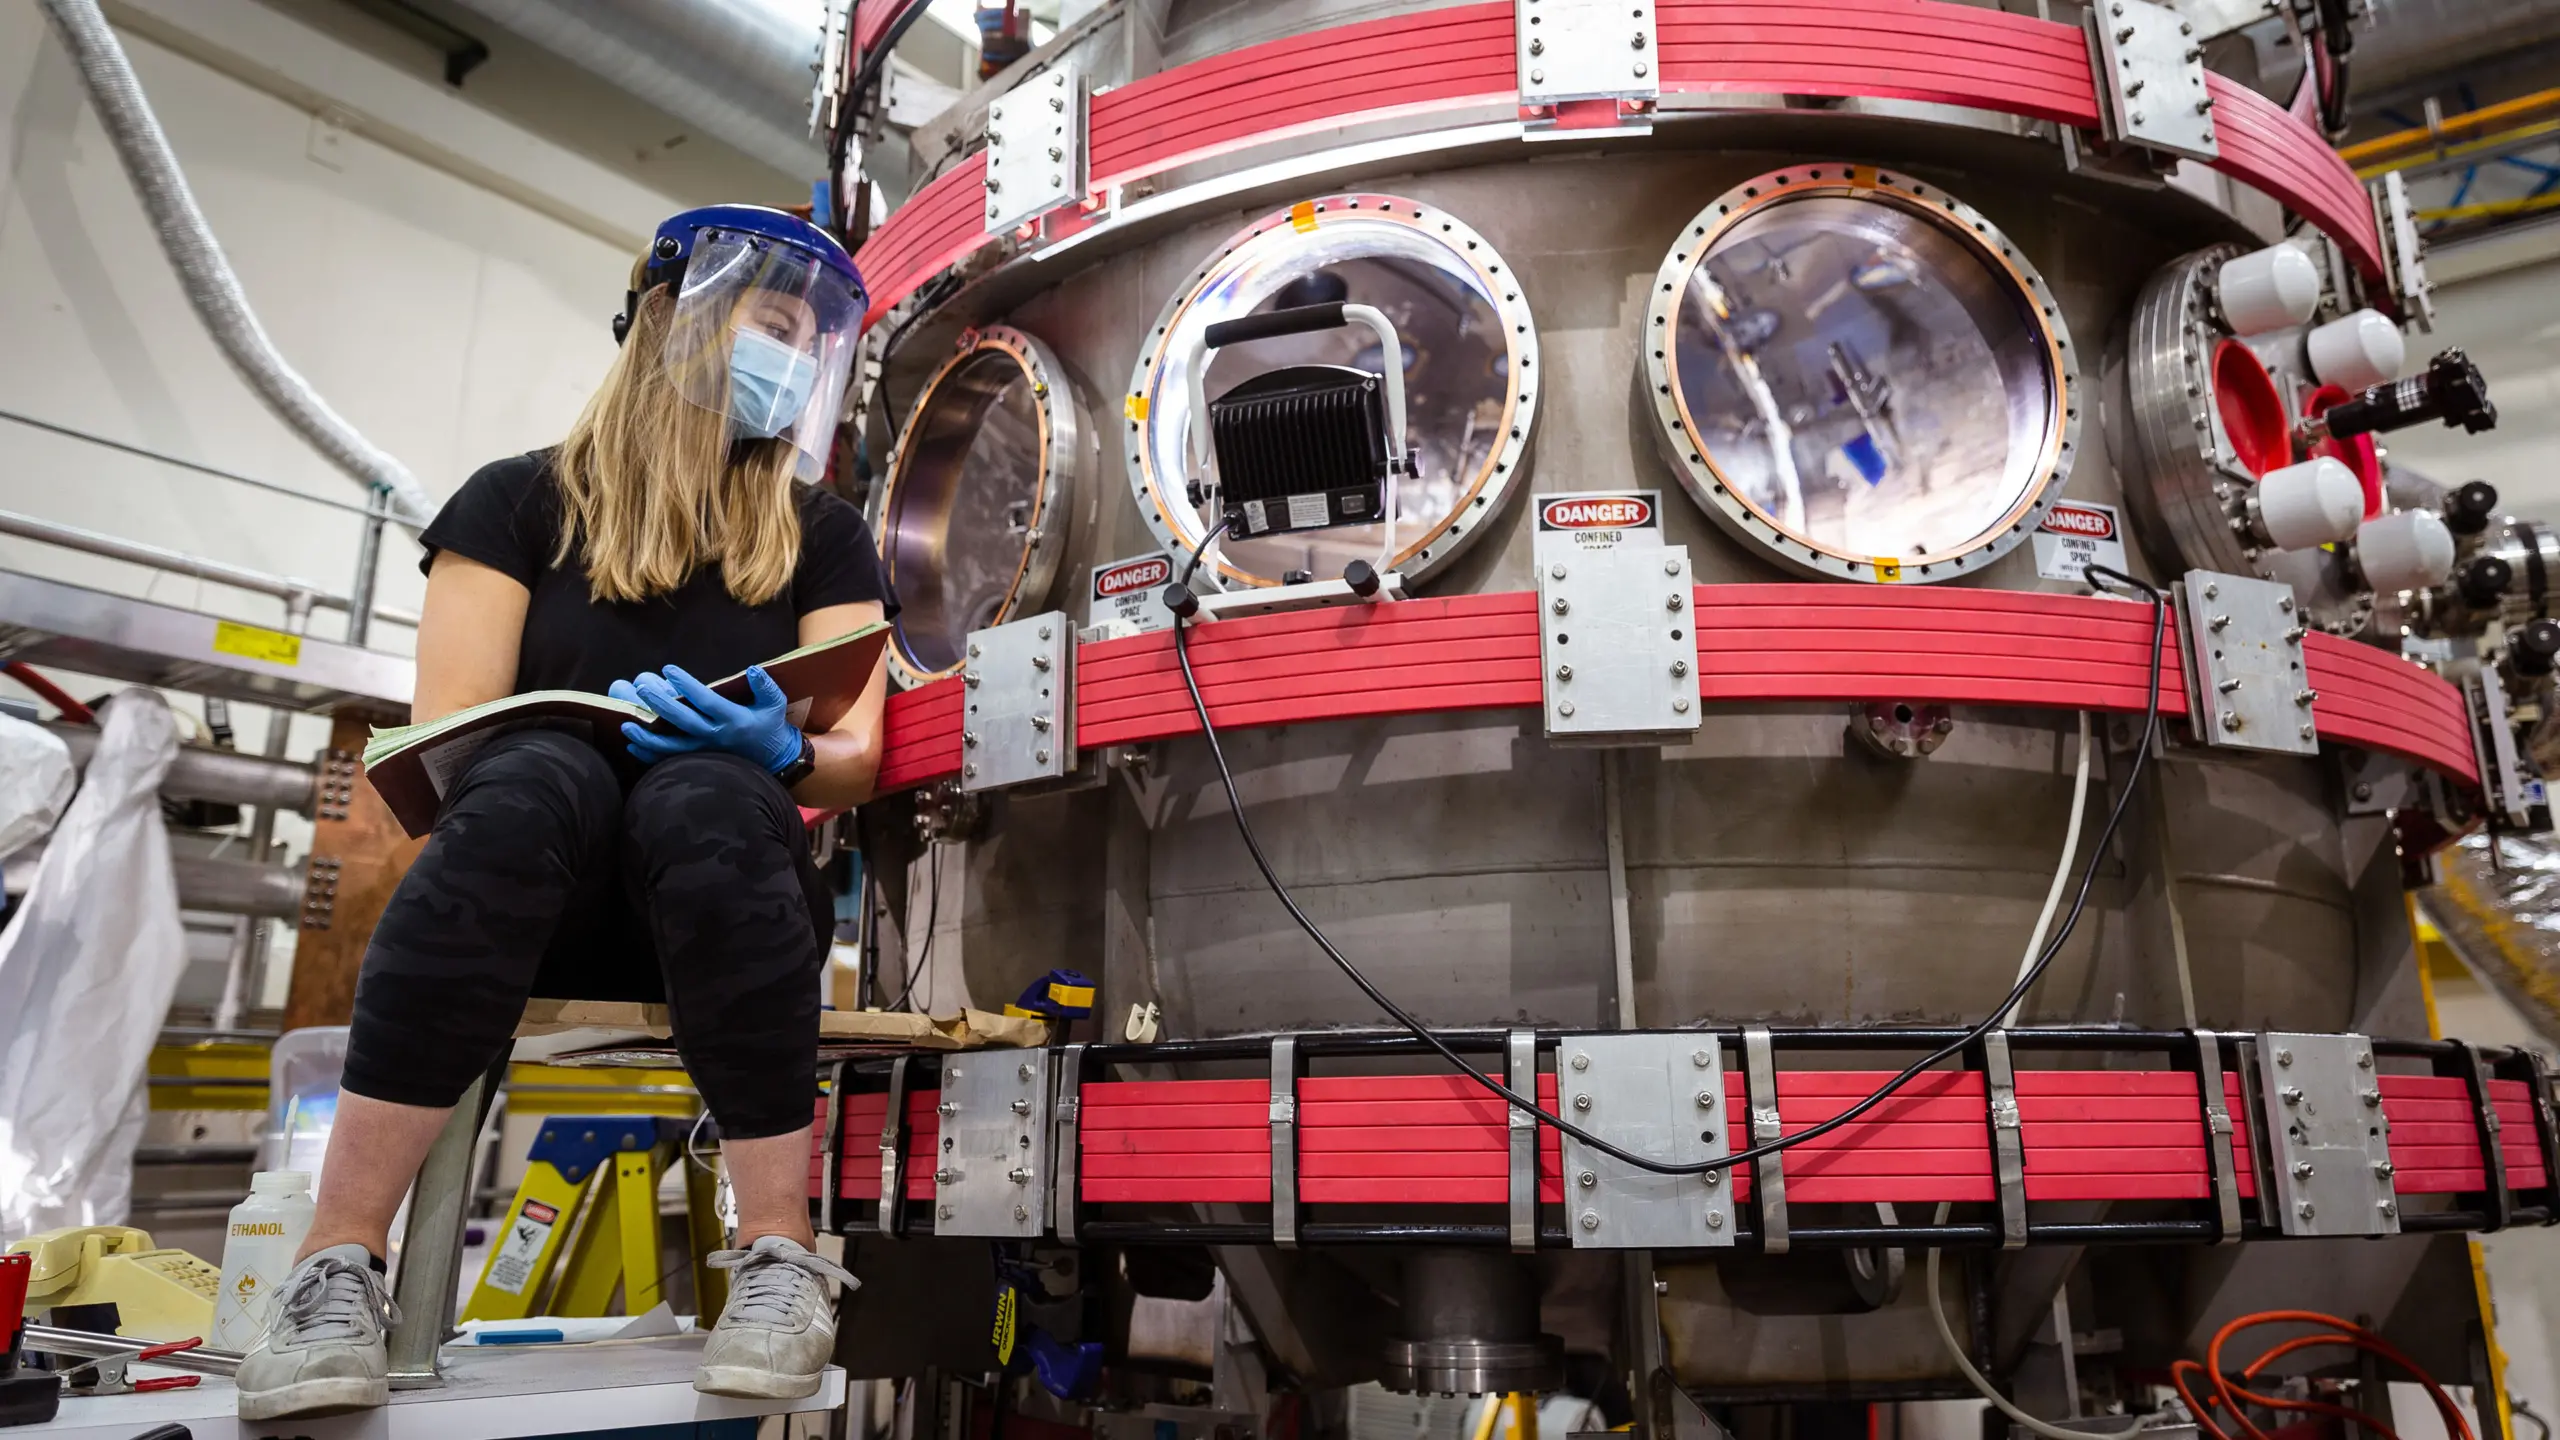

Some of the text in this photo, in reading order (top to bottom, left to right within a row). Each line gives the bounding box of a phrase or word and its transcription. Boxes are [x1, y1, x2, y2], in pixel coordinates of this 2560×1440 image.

[1555, 504, 1640, 523] DANGER
[2045, 511, 2106, 533] DANGER
[1575, 531, 1622, 544] CONFINED
[2061, 537, 2097, 552] CONFINED
[1104, 564, 1161, 592] DANGER
[1115, 591, 1148, 608] CONFINED
[1120, 605, 1141, 619] SPACE
[231, 1223, 285, 1237] ETHANOL
[992, 1292, 1007, 1346] IRWIN
